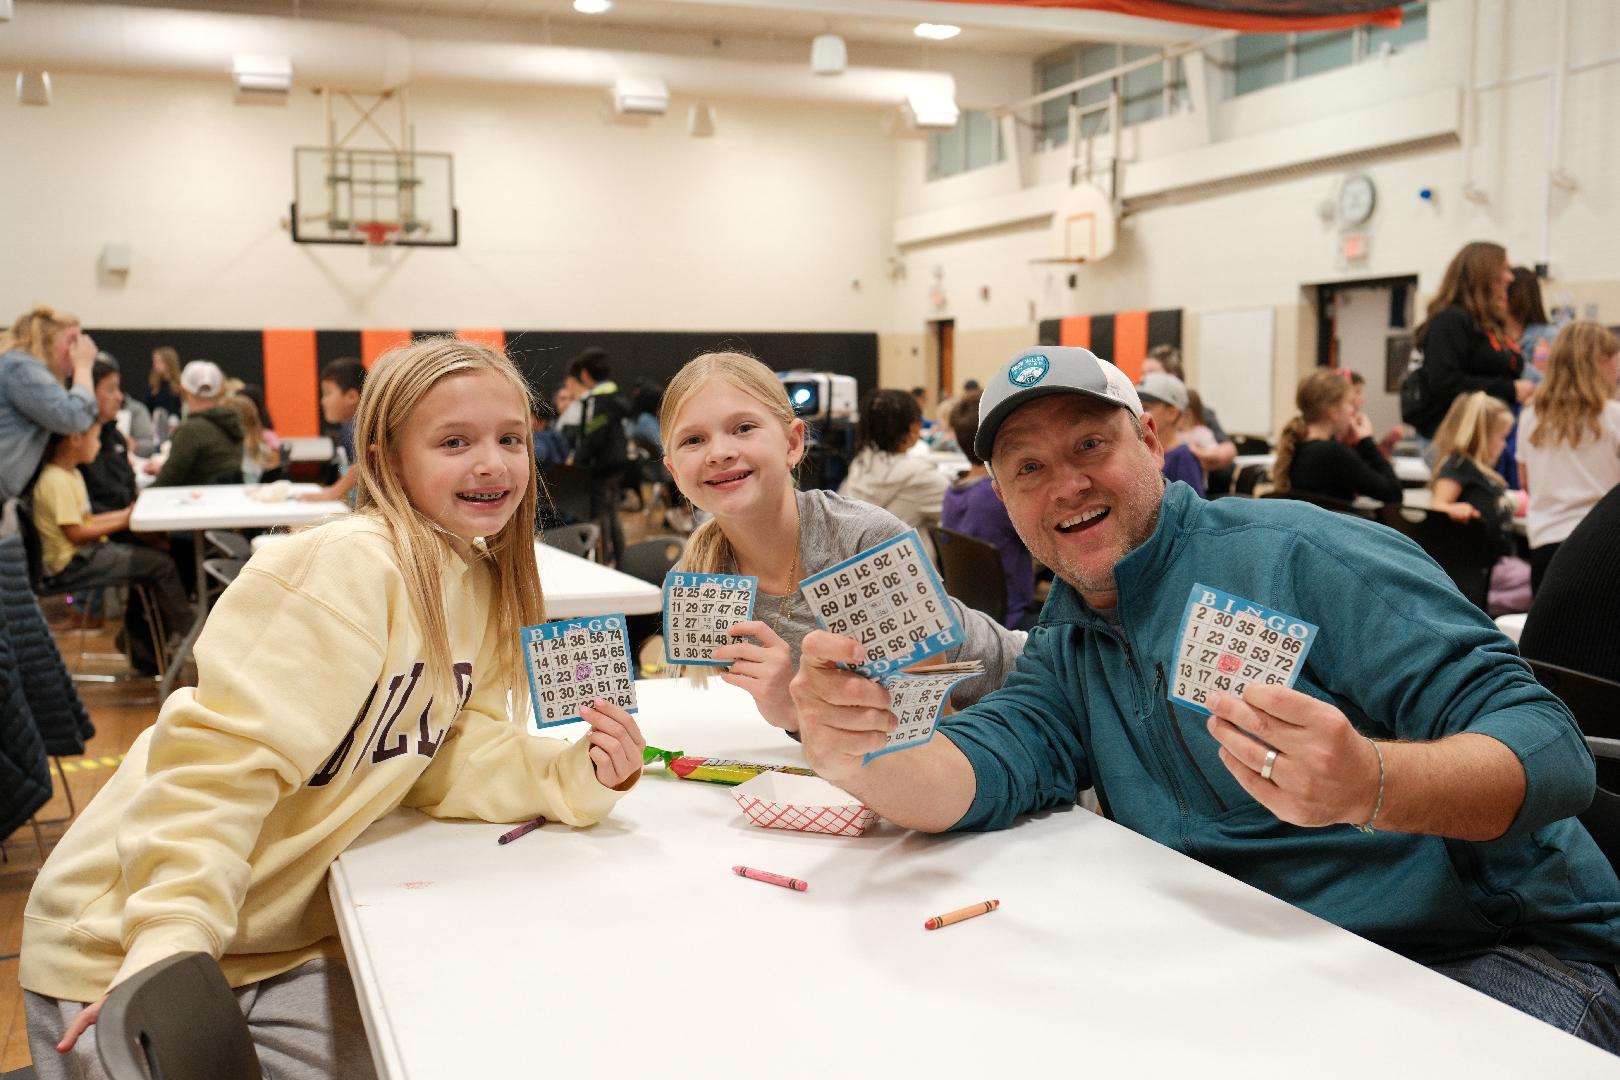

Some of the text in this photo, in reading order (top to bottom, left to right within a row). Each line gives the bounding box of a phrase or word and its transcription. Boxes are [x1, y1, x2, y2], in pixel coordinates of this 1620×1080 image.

[813, 545, 912, 598] 11 26 31 51 61
[882, 572, 900, 588] 30
[908, 564, 918, 576] 6
[674, 576, 752, 590] BINGO
[861, 582, 879, 598] 32
[673, 588, 750, 600] 12 25 42 57 72
[844, 593, 857, 608] 47
[672, 602, 747, 615] 11 29 37 47 62
[821, 601, 838, 616] 69
[829, 582, 926, 633] 9 18 58 62
[1200, 591, 1308, 639] BINGO
[530, 618, 620, 640] BINGO
[673, 618, 678, 627] 2
[685, 618, 697, 628] 27
[716, 620, 728, 629] 60
[861, 600, 936, 644] 3 17 39 57
[936, 620, 944, 631] 1
[1197, 607, 1302, 653] 2 30 35 49 66
[533, 630, 621, 652] 11 24 36 56 74
[674, 633, 742, 645] 3 16 44 48 75
[888, 635, 906, 652] 35
[909, 626, 927, 642] 20
[535, 646, 624, 669] 14 18 44 54 65
[674, 648, 680, 657] 8
[686, 649, 698, 658] 30
[868, 646, 885, 662] 59
[1193, 626, 1293, 672] 1 23 38 53 72
[538, 674, 551, 685] 13
[557, 671, 571, 682] 23
[596, 665, 608, 676] 57
[614, 662, 627, 673] 66
[1187, 645, 1195, 656] 7
[1200, 650, 1217, 664] 27
[1243, 665, 1263, 679] 57
[1266, 674, 1285, 686] 65
[1180, 664, 1192, 678] 13
[1198, 669, 1211, 683] 17
[1215, 676, 1231, 690] 43
[541, 679, 630, 702] 10 30 33 51 72
[893, 693, 904, 707] 32
[1178, 683, 1206, 703] 3 25
[547, 708, 554, 718] 8
[562, 704, 576, 716] 27
[618, 695, 632, 706] 64
[908, 689, 932, 740] 11 25 39
[922, 689, 945, 735] 6 28 41
[896, 710, 911, 740] 5 27
